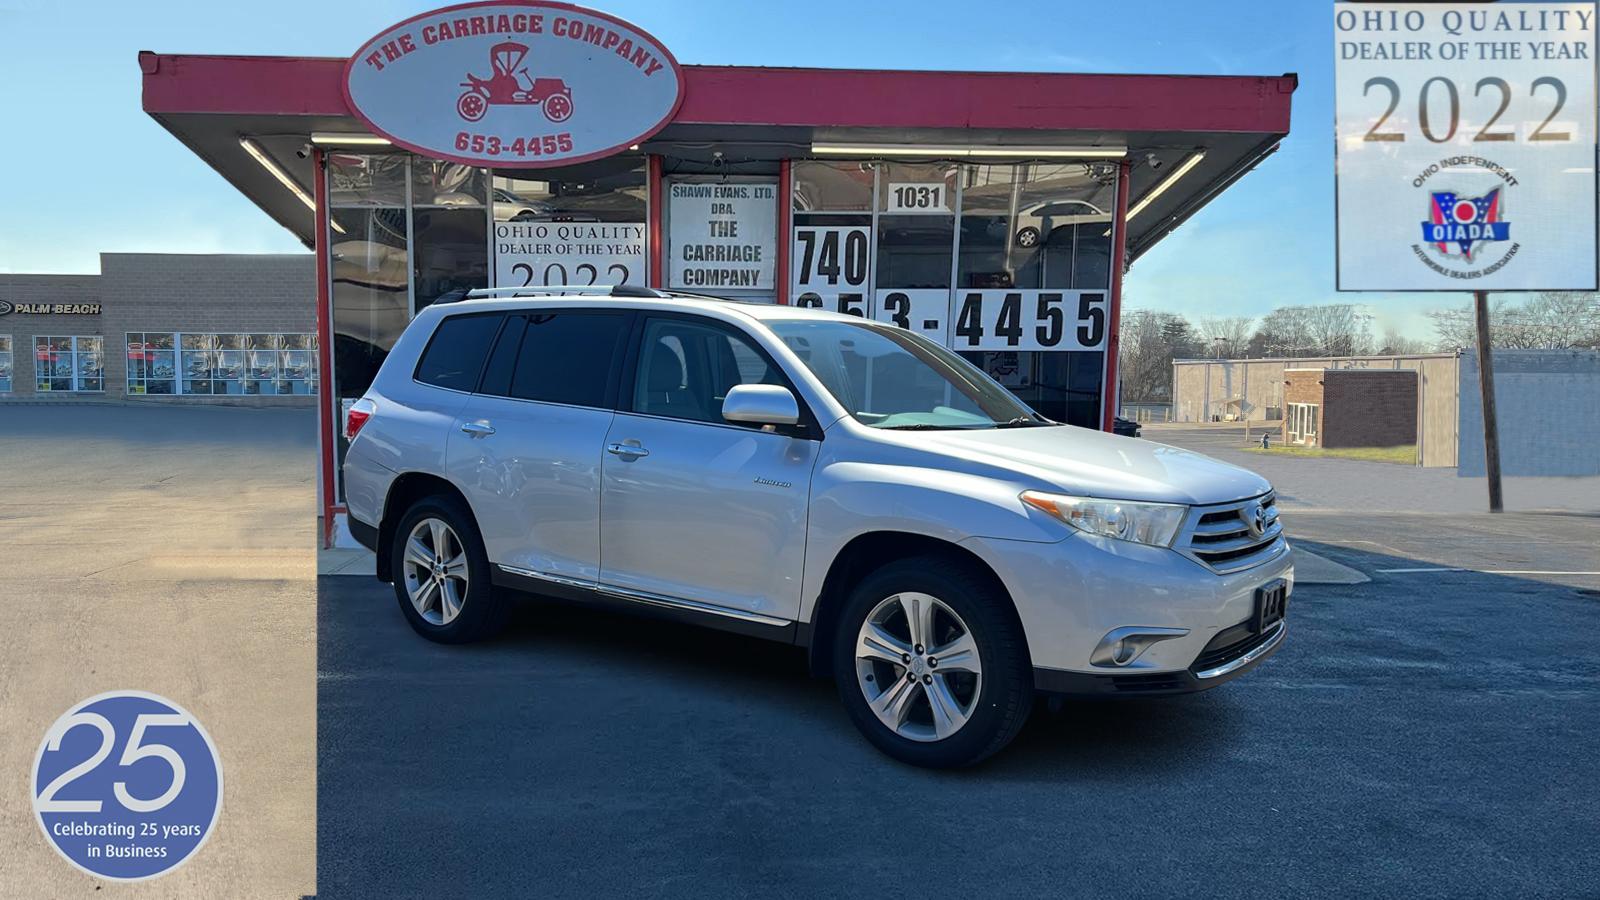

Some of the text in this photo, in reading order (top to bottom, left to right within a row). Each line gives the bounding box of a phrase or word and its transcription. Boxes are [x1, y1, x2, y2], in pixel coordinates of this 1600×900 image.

[1336, 10, 1592, 35] OHIO QUALITY
[366, 14, 664, 77] THE CARRIAGE COMPANY
[1340, 42, 1589, 60] DEALER OF THE YEAR
[1363, 76, 1571, 143] 2022
[455, 131, 573, 156] 653-4455
[1412, 156, 1519, 188] OHIO INDEPENDENT
[673, 186, 711, 198] SHAWN
[754, 187, 774, 199] LTD.
[894, 186, 940, 208] 1031
[711, 203, 735, 215] DBA.
[497, 226, 644, 241] OHIO QUALITY
[709, 221, 737, 237] THE
[1433, 224, 1495, 240] OIADA
[500, 244, 641, 255] DEALER OF THE YEAR
[683, 244, 762, 262] CARRIAGE
[797, 229, 868, 285] 740
[1450, 270, 1482, 280] DEALERS
[1483, 242, 1521, 276] ASSOCIATION
[683, 268, 760, 286] COMPANY
[14, 304, 100, 314] PALM BEACH
